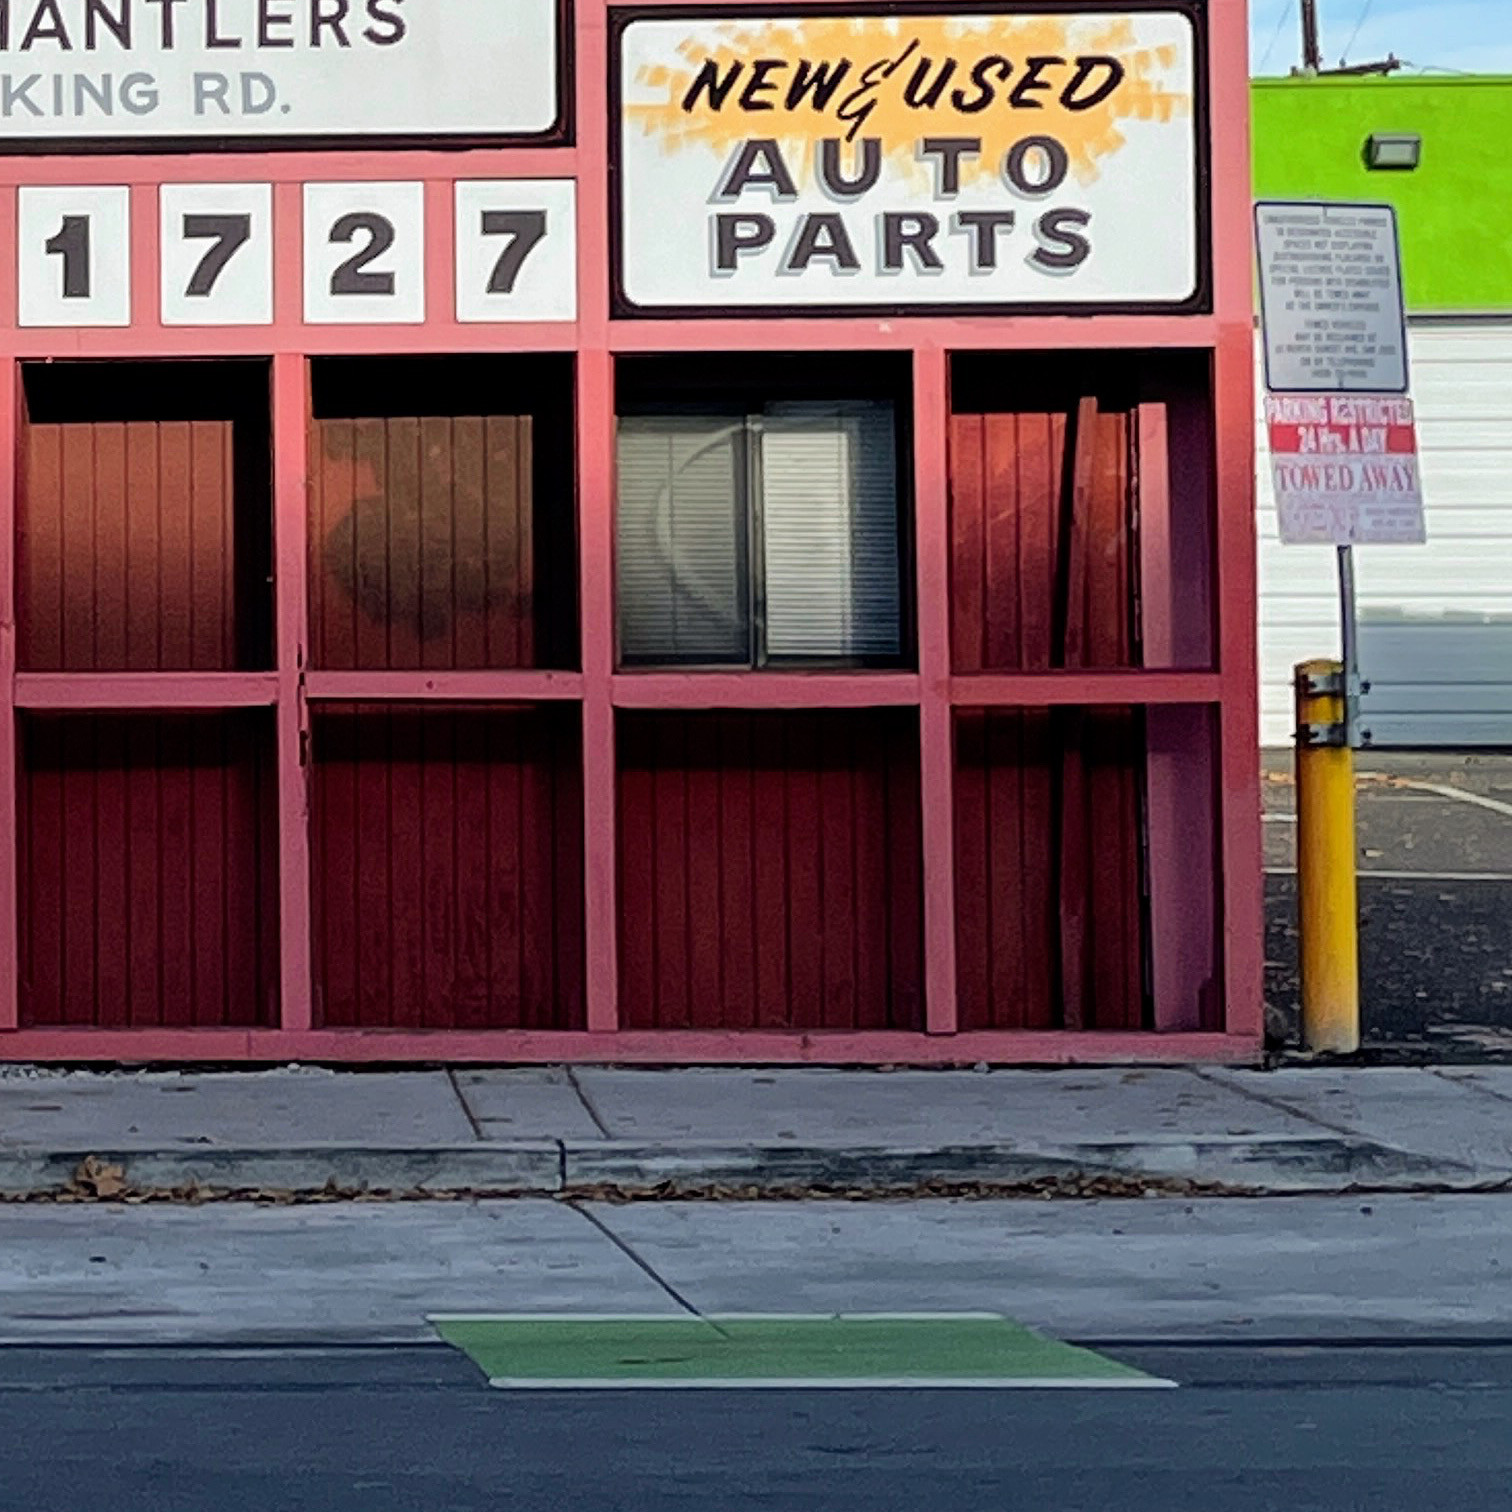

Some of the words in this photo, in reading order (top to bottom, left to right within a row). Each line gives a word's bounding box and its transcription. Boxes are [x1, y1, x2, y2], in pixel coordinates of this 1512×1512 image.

[0, 72, 160, 118] KING
[192, 70, 292, 116] RD.
[681, 57, 852, 114] NEW
[901, 54, 1126, 113] USED
[710, 134, 1070, 202] AUTO
[710, 208, 1092, 276] PARTS
[1276, 463, 1354, 492] TOWED
[1361, 462, 1414, 492] AWAY
